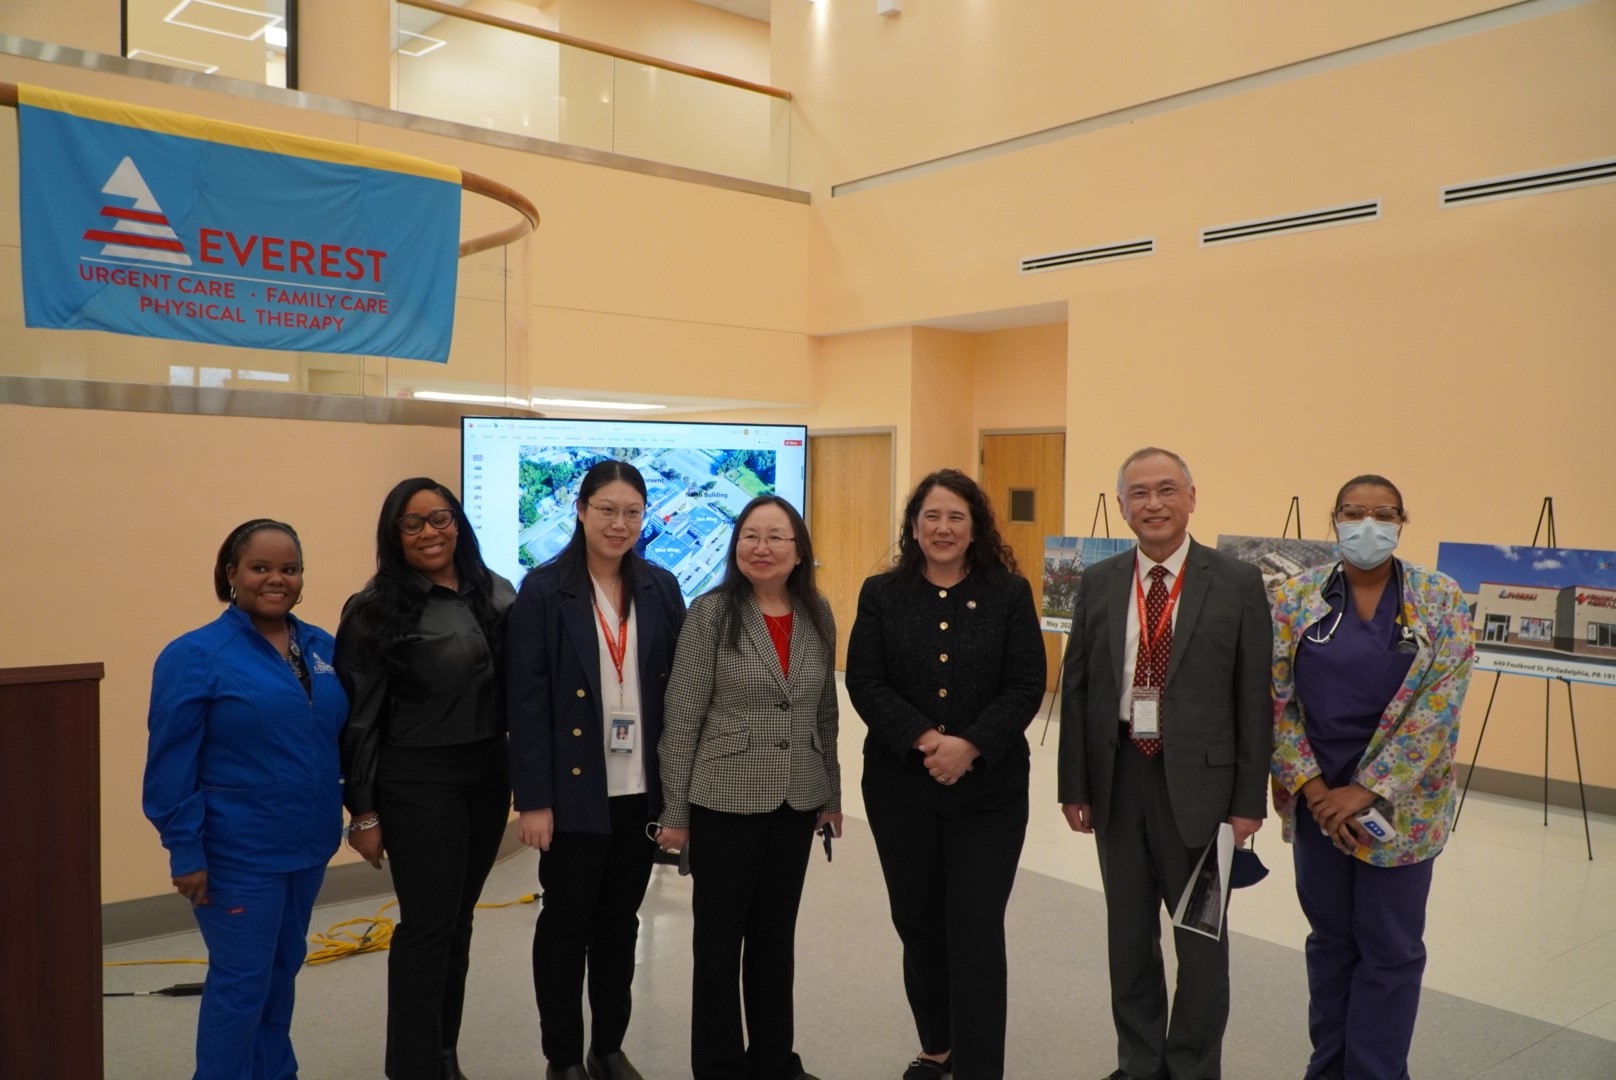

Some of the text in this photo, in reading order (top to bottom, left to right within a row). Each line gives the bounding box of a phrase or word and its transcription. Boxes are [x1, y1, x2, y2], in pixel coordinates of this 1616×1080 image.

[199, 227, 387, 283] EVEREST
[79, 264, 389, 314] URGENT CARE FAMILY CARE
[139, 296, 345, 331] PHYSICAL THERAPY
[704, 491, 728, 499] Building
[1046, 620, 1072, 629] May 202
[1546, 666, 1591, 677] Philadelphia,
[1603, 672, 1616, 680] 191
